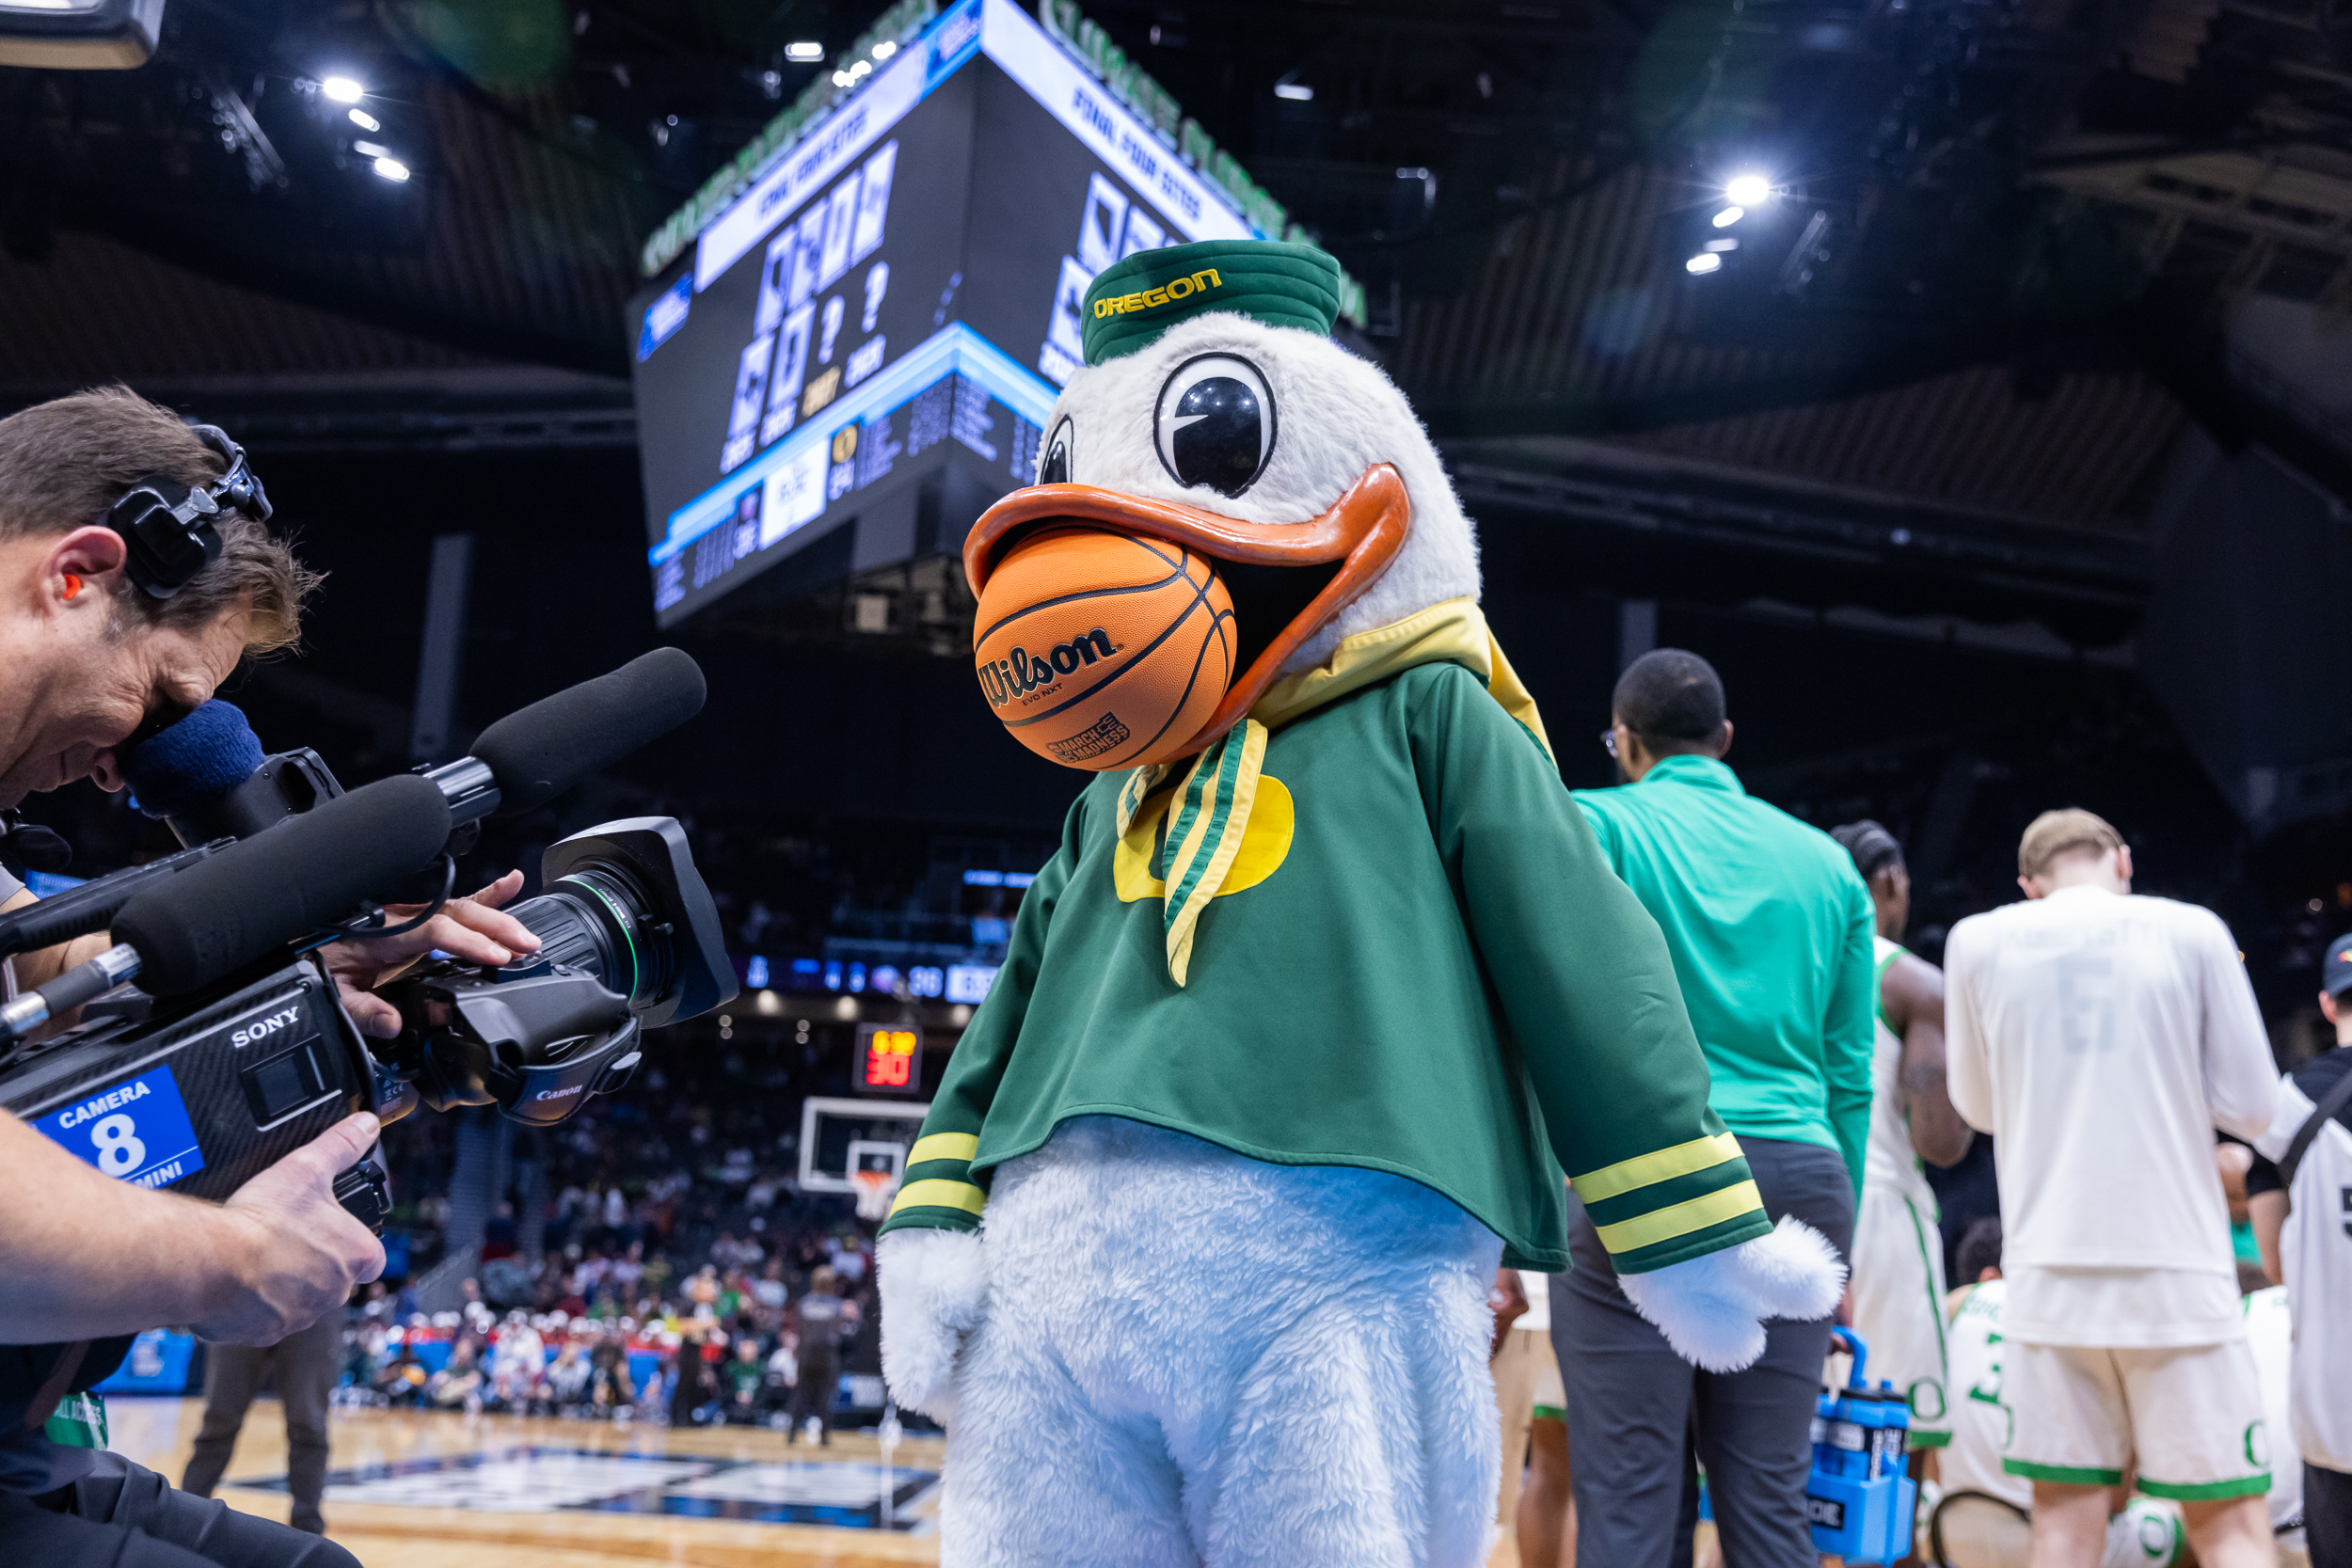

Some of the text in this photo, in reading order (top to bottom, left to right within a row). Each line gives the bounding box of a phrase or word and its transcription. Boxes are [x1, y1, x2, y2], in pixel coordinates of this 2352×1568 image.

[1072, 86, 1117, 148] FINAL
[1093, 268, 1223, 319] OREGON
[977, 627, 1119, 708] Wilson
[1022, 682, 1063, 706] EVO NXT
[1057, 728, 1101, 753] MARCH
[1072, 723, 1129, 762] MADNESS
[230, 1006, 299, 1049] SONY
[58, 1081, 151, 1129] CAMERA
[536, 1085, 583, 1101] Canon
[90, 1113, 147, 1177] 8
